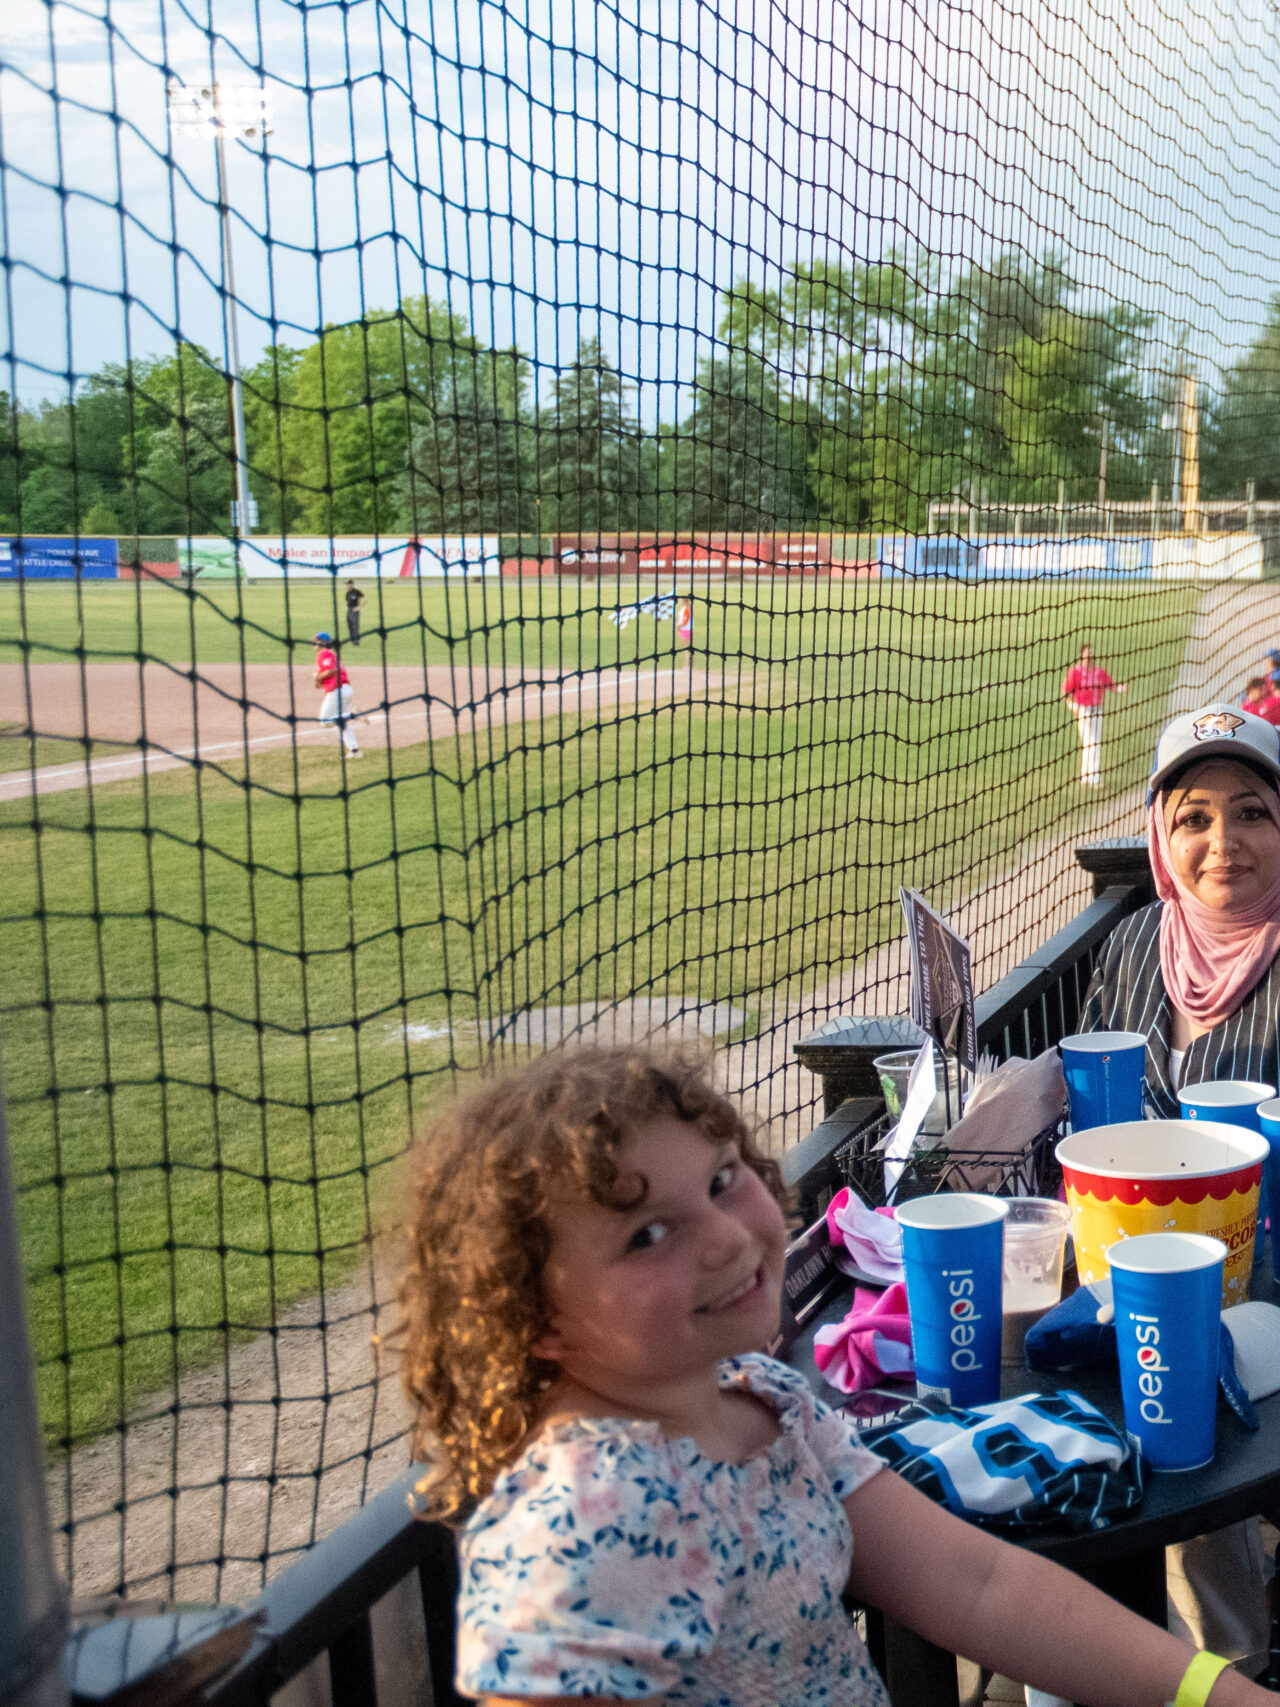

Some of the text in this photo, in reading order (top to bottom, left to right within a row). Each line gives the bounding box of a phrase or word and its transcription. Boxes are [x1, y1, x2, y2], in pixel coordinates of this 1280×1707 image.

[268, 547, 379, 561] Make an Impac
[916, 910, 931, 1030] WELCOME TO THE
[961, 953, 974, 1062] GUIDES AND TIPS
[784, 1252, 826, 1300] OAKLAWN
[942, 1269, 982, 1372] pepsi
[1129, 1313, 1173, 1424] pepsi
